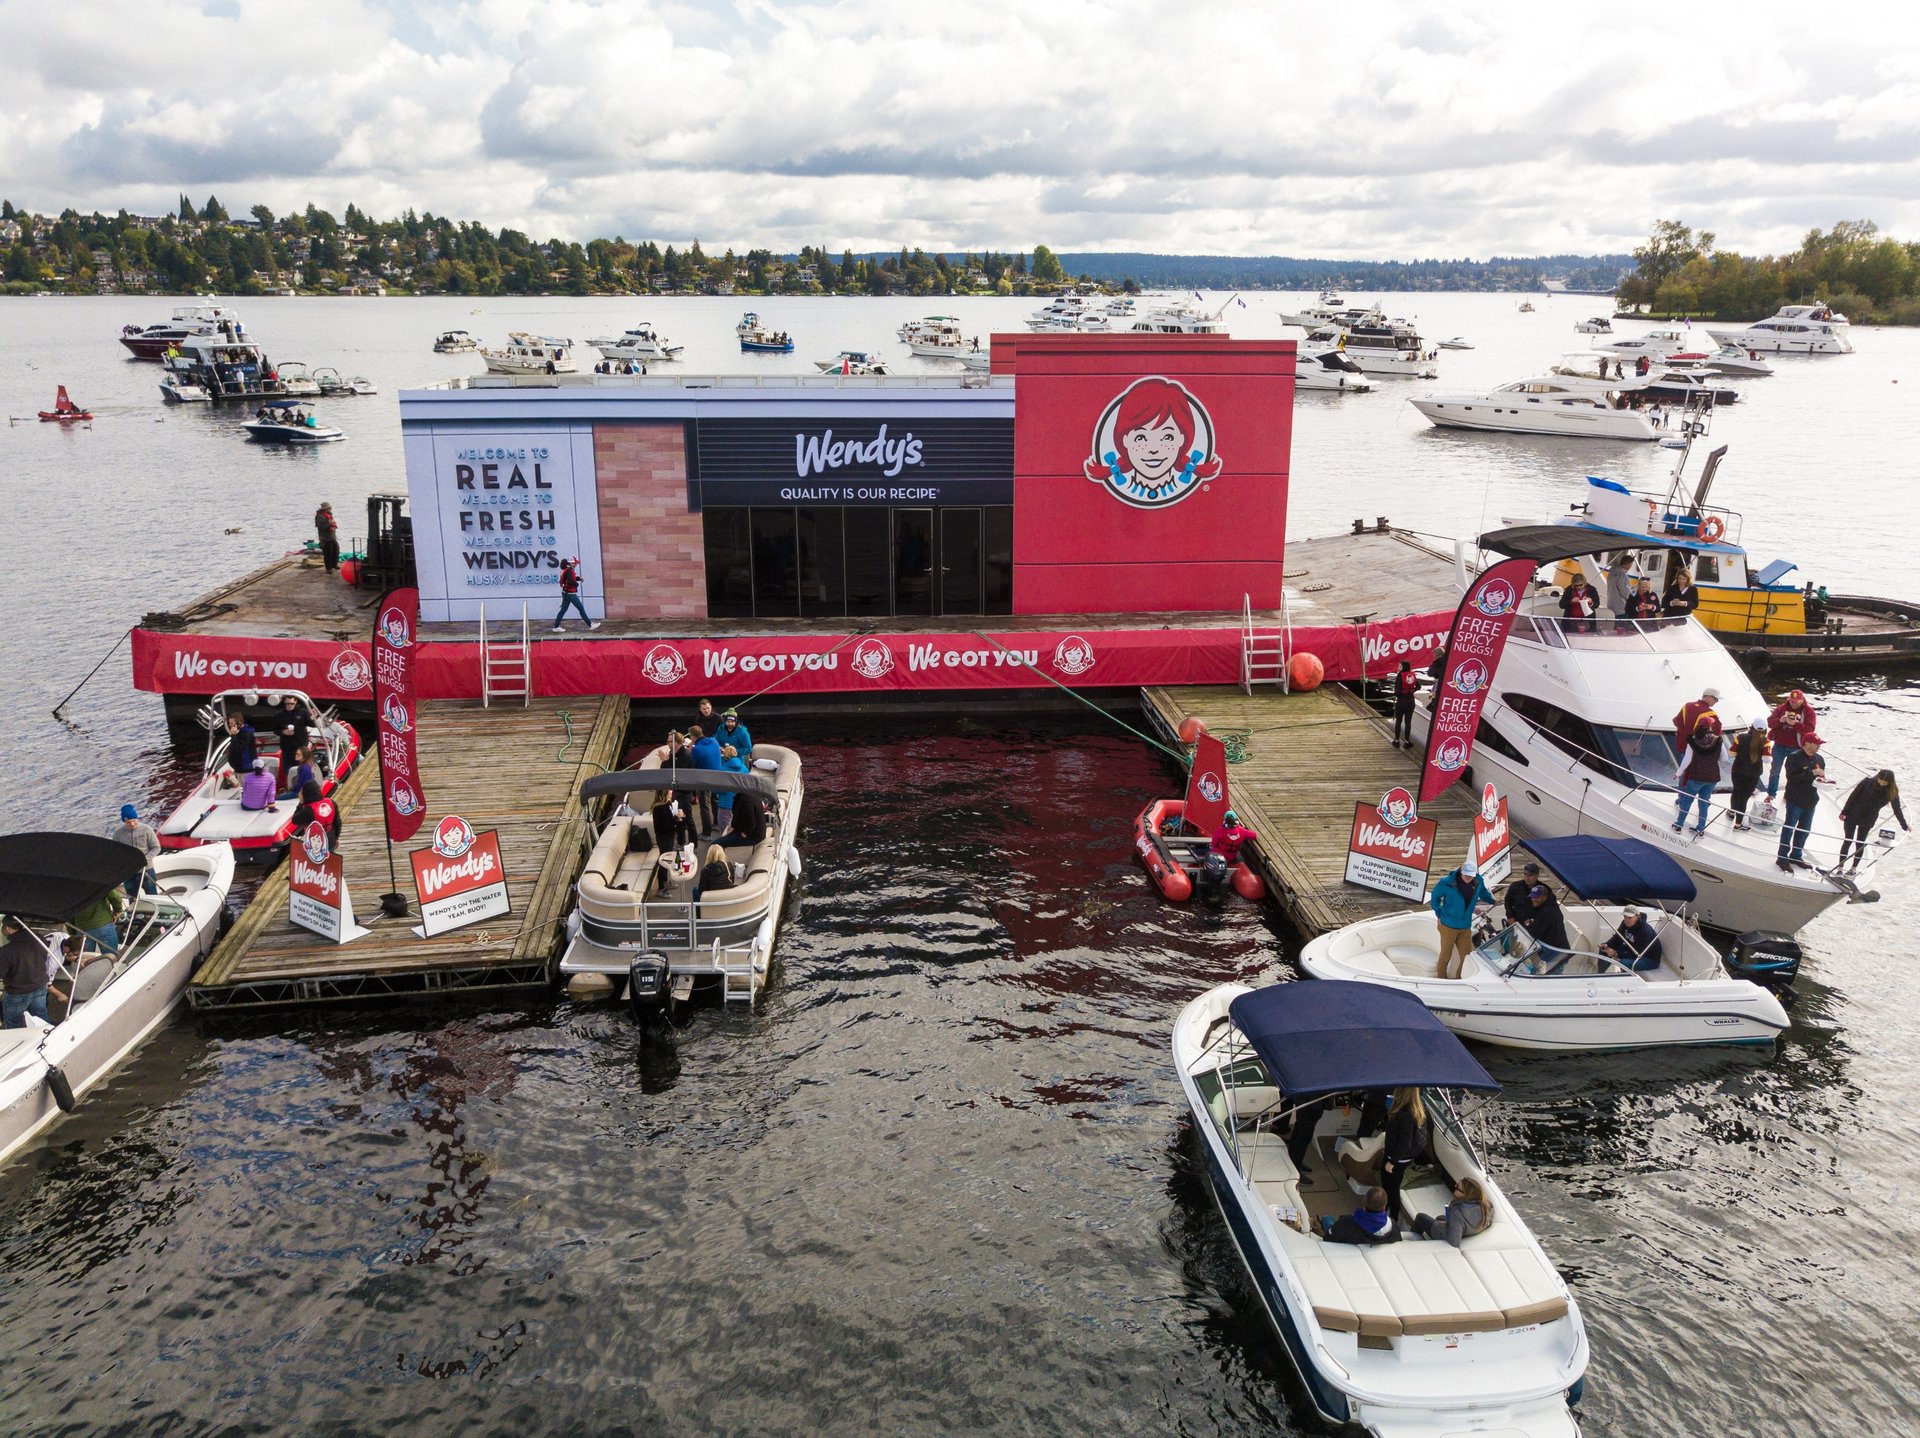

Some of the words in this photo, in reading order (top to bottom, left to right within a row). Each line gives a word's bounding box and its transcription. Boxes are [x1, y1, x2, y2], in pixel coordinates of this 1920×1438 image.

[456, 448, 526, 460] WELCOME
[531, 448, 549, 459] TO
[796, 424, 923, 477] Wendy's
[456, 463, 553, 490] REAL
[459, 494, 529, 505] WELCOME
[535, 494, 553, 504] TO
[780, 488, 839, 500] QUALITY
[843, 488, 854, 499] IS
[858, 488, 886, 499] OUR
[459, 510, 556, 531] FRESH
[464, 535, 533, 547] WELCOME
[538, 534, 557, 546] TO
[462, 550, 560, 570] WENDY'S
[466, 574, 505, 586] HUSKY
[510, 573, 560, 585] HARBOR
[1459, 616, 1503, 637] FREE
[1361, 634, 1391, 663] We
[1393, 633, 1433, 654] GOT
[1456, 631, 1494, 646] SPICY
[377, 646, 406, 671] FREE
[908, 642, 939, 671] We
[943, 650, 992, 667] GOT
[995, 650, 1038, 667] YOU
[1453, 642, 1494, 657] NUGGS!
[175, 650, 206, 679] We
[211, 659, 258, 677] GOT
[261, 661, 307, 679] YOU
[377, 662, 402, 681] SPICY
[704, 648, 736, 678] We
[740, 654, 787, 671] GOT
[791, 653, 838, 670] YOU
[377, 673, 405, 693] NUGGS!
[1441, 697, 1478, 713] FREE
[1439, 711, 1472, 723] SPICY
[1436, 722, 1472, 733] NUGGS!
[1358, 823, 1426, 858] Wendy's
[1478, 816, 1506, 858] Wendy's
[294, 859, 337, 896] Wendy's
[422, 851, 494, 895] Wendy's
[1385, 866, 1412, 878] BURGERS
[1357, 872, 1382, 884] WENDY'S
[1397, 884, 1413, 893] BOAT
[429, 904, 457, 917] WENDY'S
[457, 901, 468, 909] ON
[469, 897, 482, 905] THE
[482, 891, 502, 901] WATER
[467, 903, 487, 914] BUOY!
